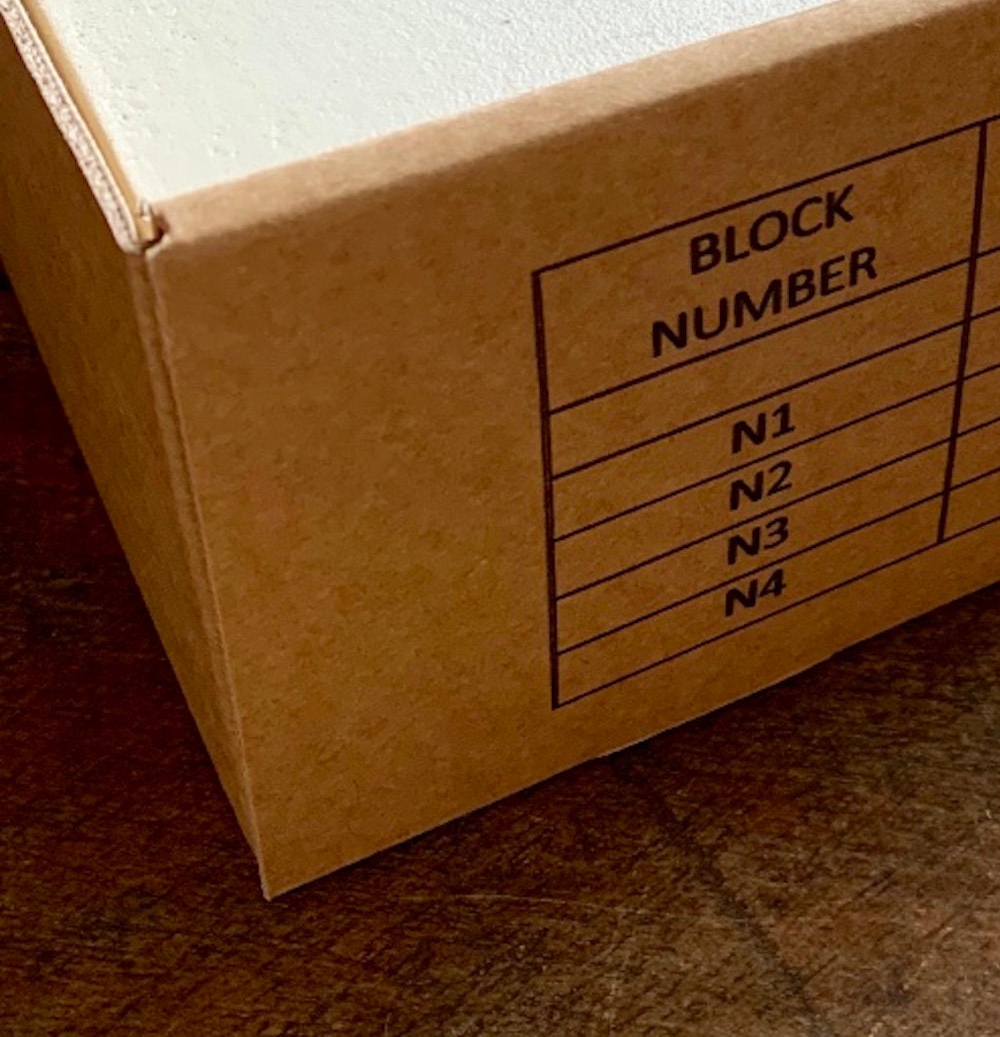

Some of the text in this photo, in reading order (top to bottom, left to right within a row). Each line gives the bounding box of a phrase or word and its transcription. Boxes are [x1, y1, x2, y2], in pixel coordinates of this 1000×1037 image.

[689, 184, 854, 276] BLOCK
[651, 246, 878, 359] NUMBER
[731, 402, 796, 454] N1
[729, 460, 793, 511] N2
[727, 516, 789, 565] N3
[725, 568, 787, 617] N4
